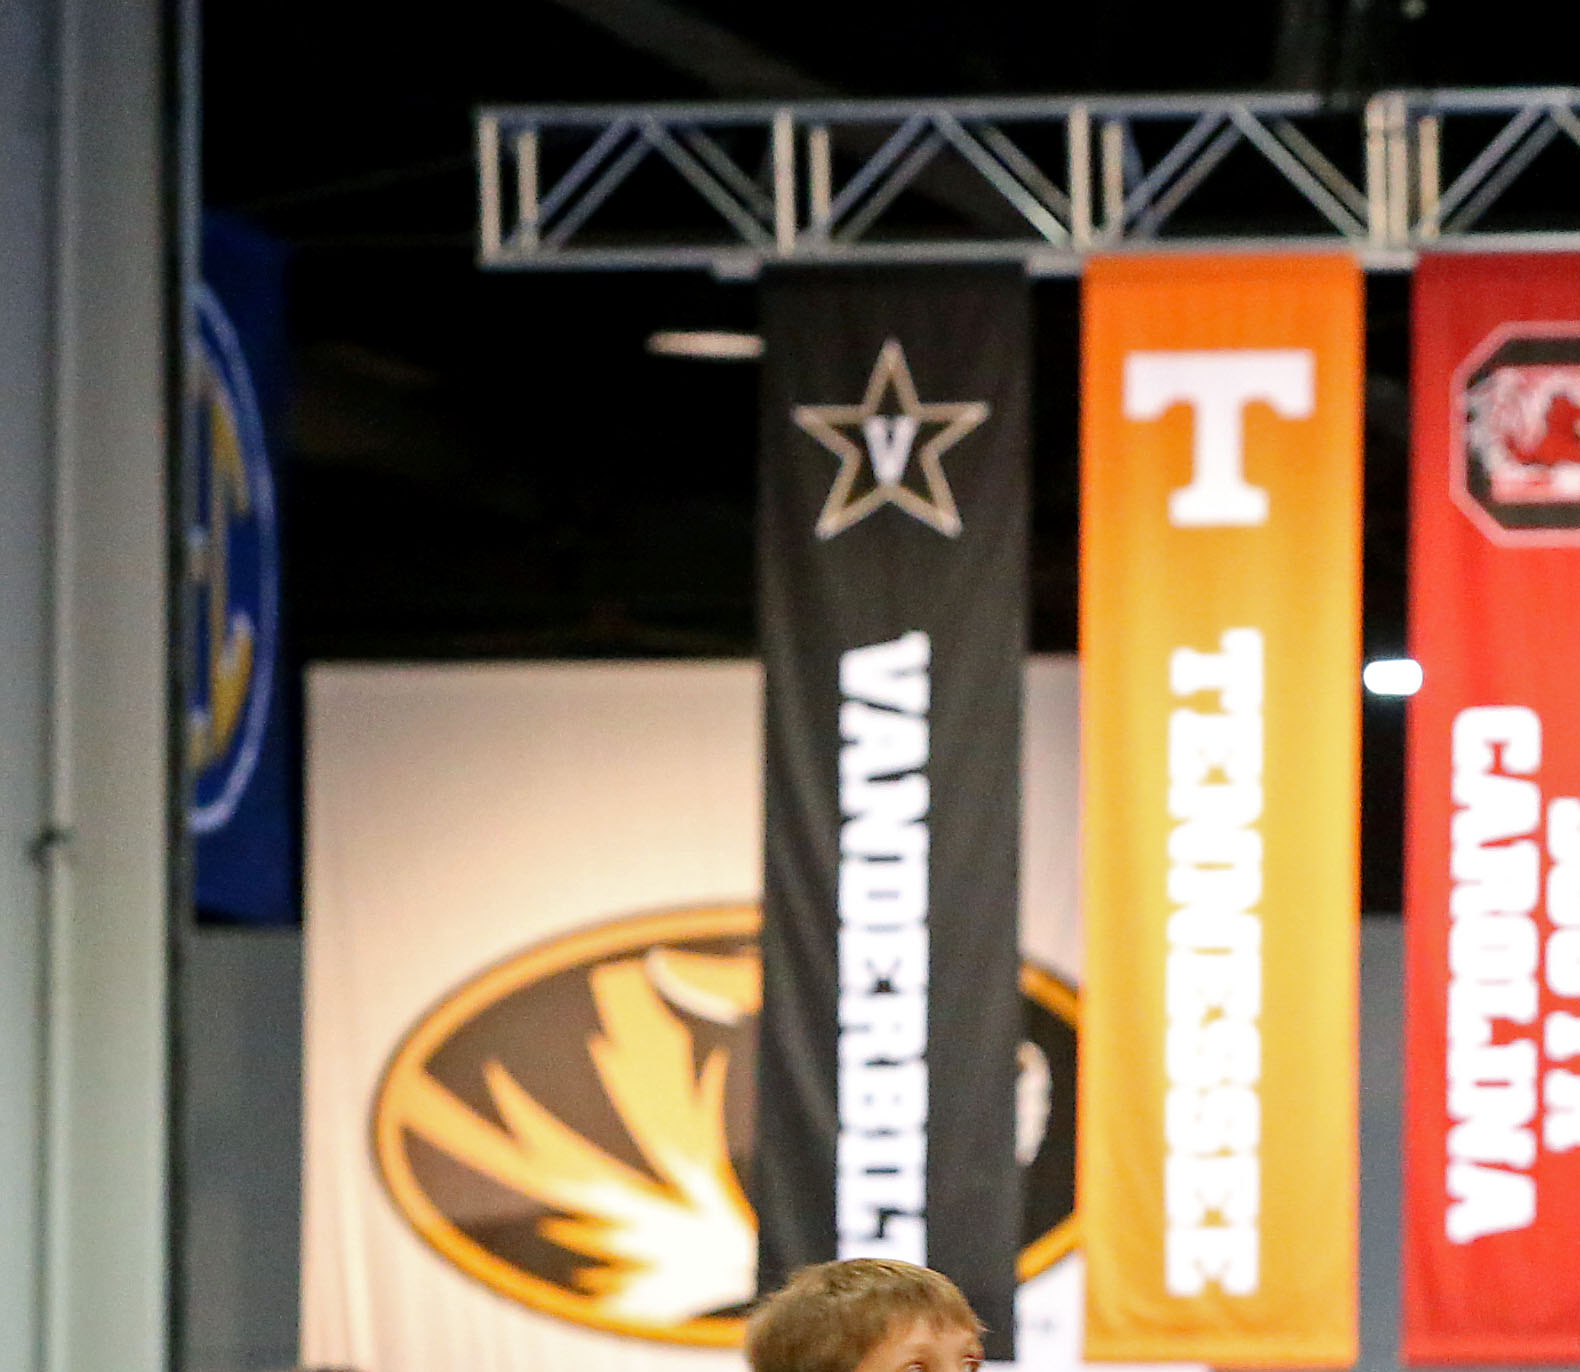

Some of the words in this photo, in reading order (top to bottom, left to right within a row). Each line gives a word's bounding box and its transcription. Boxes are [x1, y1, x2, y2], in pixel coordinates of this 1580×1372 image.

[863, 414, 919, 487] V
[1121, 348, 1317, 528] T
[1165, 626, 1264, 1297] TENNESSEE
[1445, 704, 1543, 1246] CAROLINA
